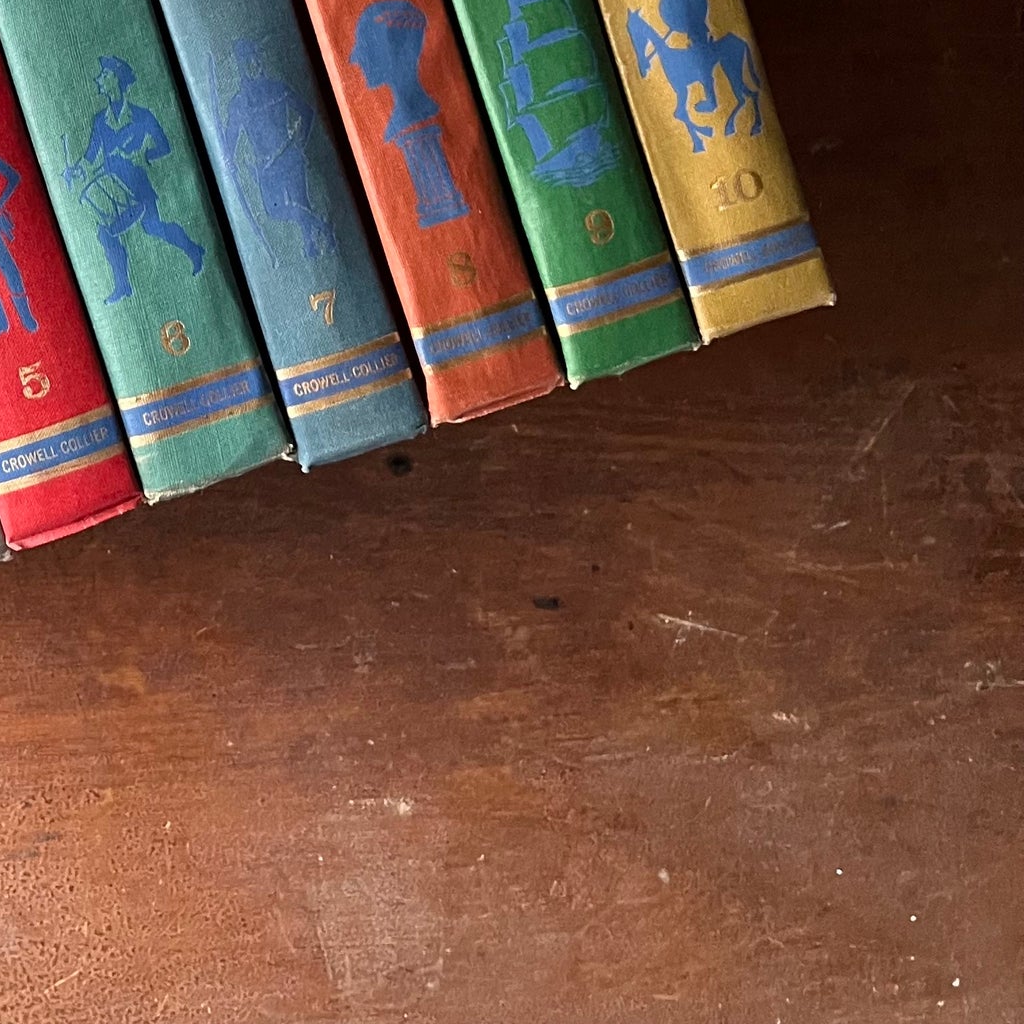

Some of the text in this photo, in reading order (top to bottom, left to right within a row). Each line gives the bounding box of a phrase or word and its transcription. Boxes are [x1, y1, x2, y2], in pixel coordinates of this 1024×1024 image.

[709, 167, 765, 212] 10
[585, 208, 616, 246] 9
[309, 288, 338, 326] 7
[160, 319, 192, 357] 6
[18, 360, 52, 401] 5
